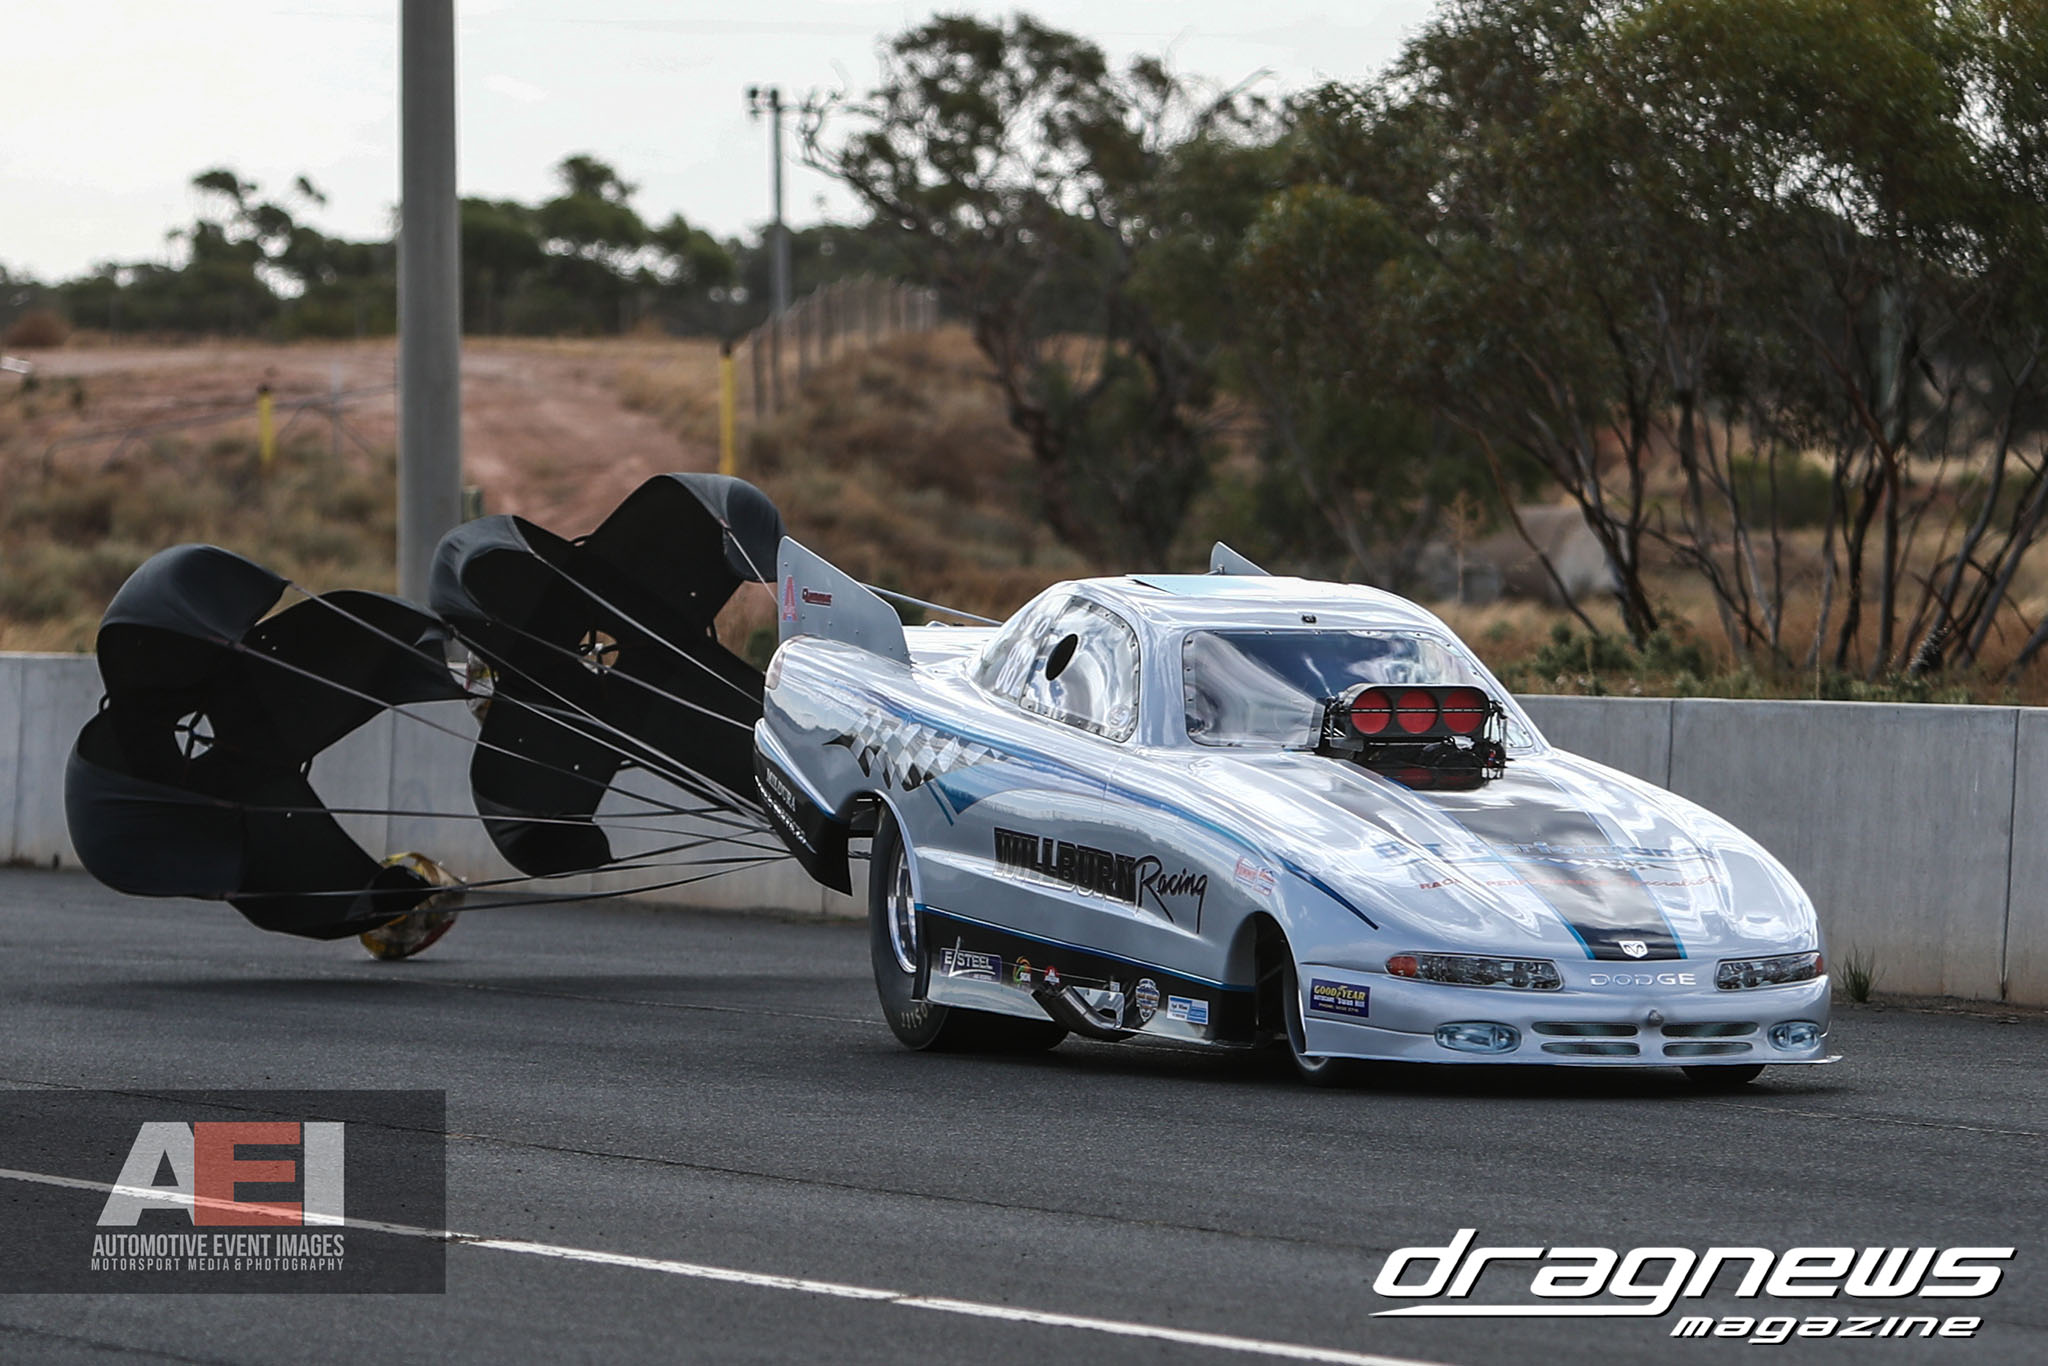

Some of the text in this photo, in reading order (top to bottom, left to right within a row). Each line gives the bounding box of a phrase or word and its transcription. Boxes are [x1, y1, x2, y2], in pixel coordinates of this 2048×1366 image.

[765, 767, 796, 812] MILDURA
[993, 827, 1137, 906] WILLBURN
[1134, 855, 1209, 934] Racing
[1313, 985, 1366, 1001] GOODYEAR
[1590, 973, 1697, 986] DODGE
